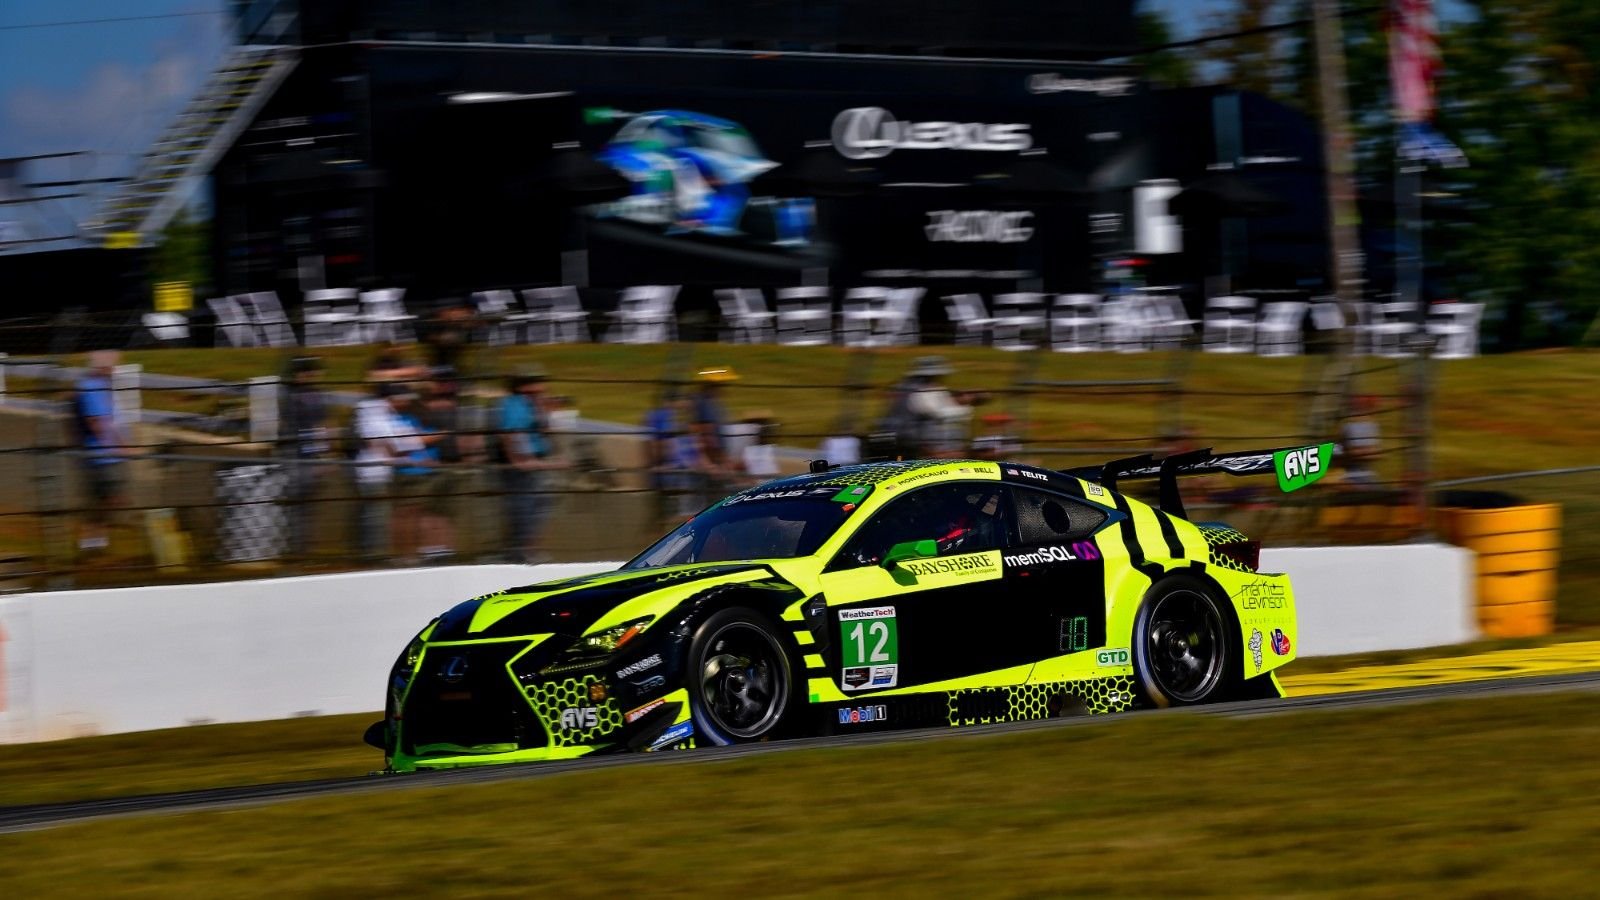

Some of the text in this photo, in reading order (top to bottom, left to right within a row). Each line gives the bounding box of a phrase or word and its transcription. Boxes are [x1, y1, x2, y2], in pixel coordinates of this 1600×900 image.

[1284, 447, 1320, 480] AVS
[898, 469, 949, 486] MONTECALVO
[1021, 470, 1048, 482] TELITZ
[907, 554, 994, 576] BAYSHORE
[1004, 546, 1077, 568] memSQL
[841, 608, 893, 619] WeatherTech
[850, 621, 889, 663] 12
[1098, 651, 1128, 664] GTD
[561, 707, 598, 730] AVS
[839, 706, 875, 723] Mobil
